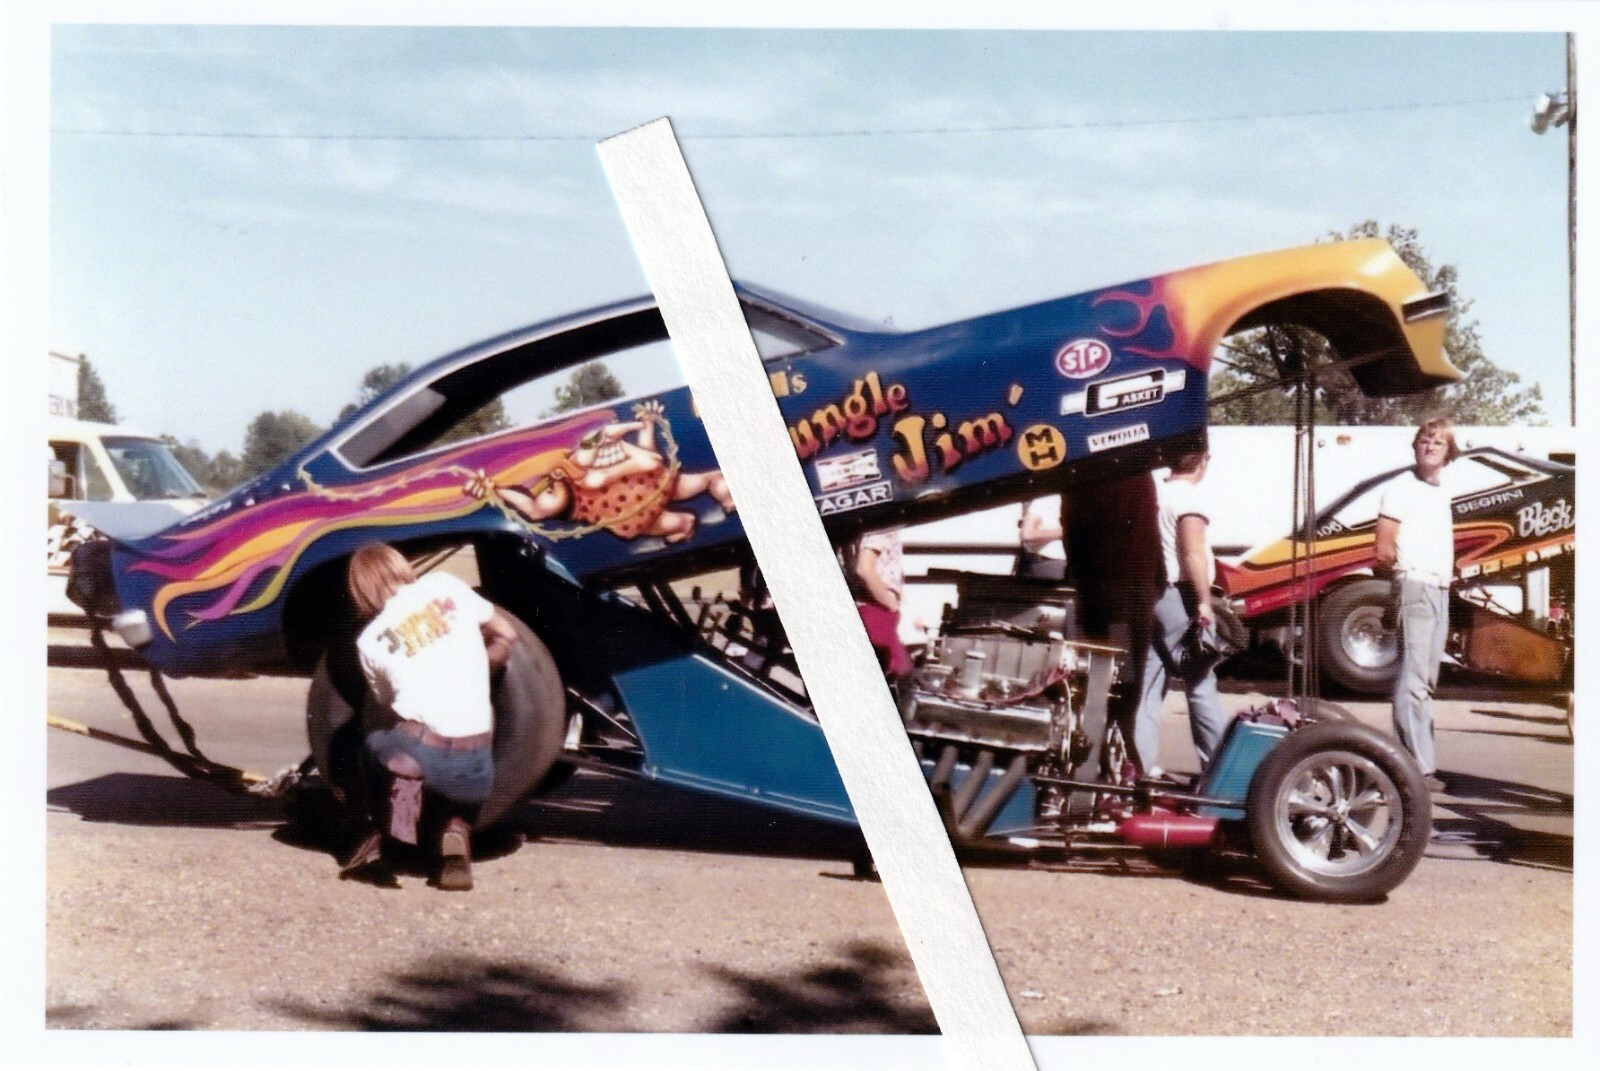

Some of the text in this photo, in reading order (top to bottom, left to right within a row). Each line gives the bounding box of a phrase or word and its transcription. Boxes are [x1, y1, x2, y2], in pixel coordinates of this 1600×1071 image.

[1063, 343, 1102, 370] STP
[788, 370, 909, 459] ungle
[820, 485, 889, 514] AGAR
[1516, 499, 1575, 538] Black
